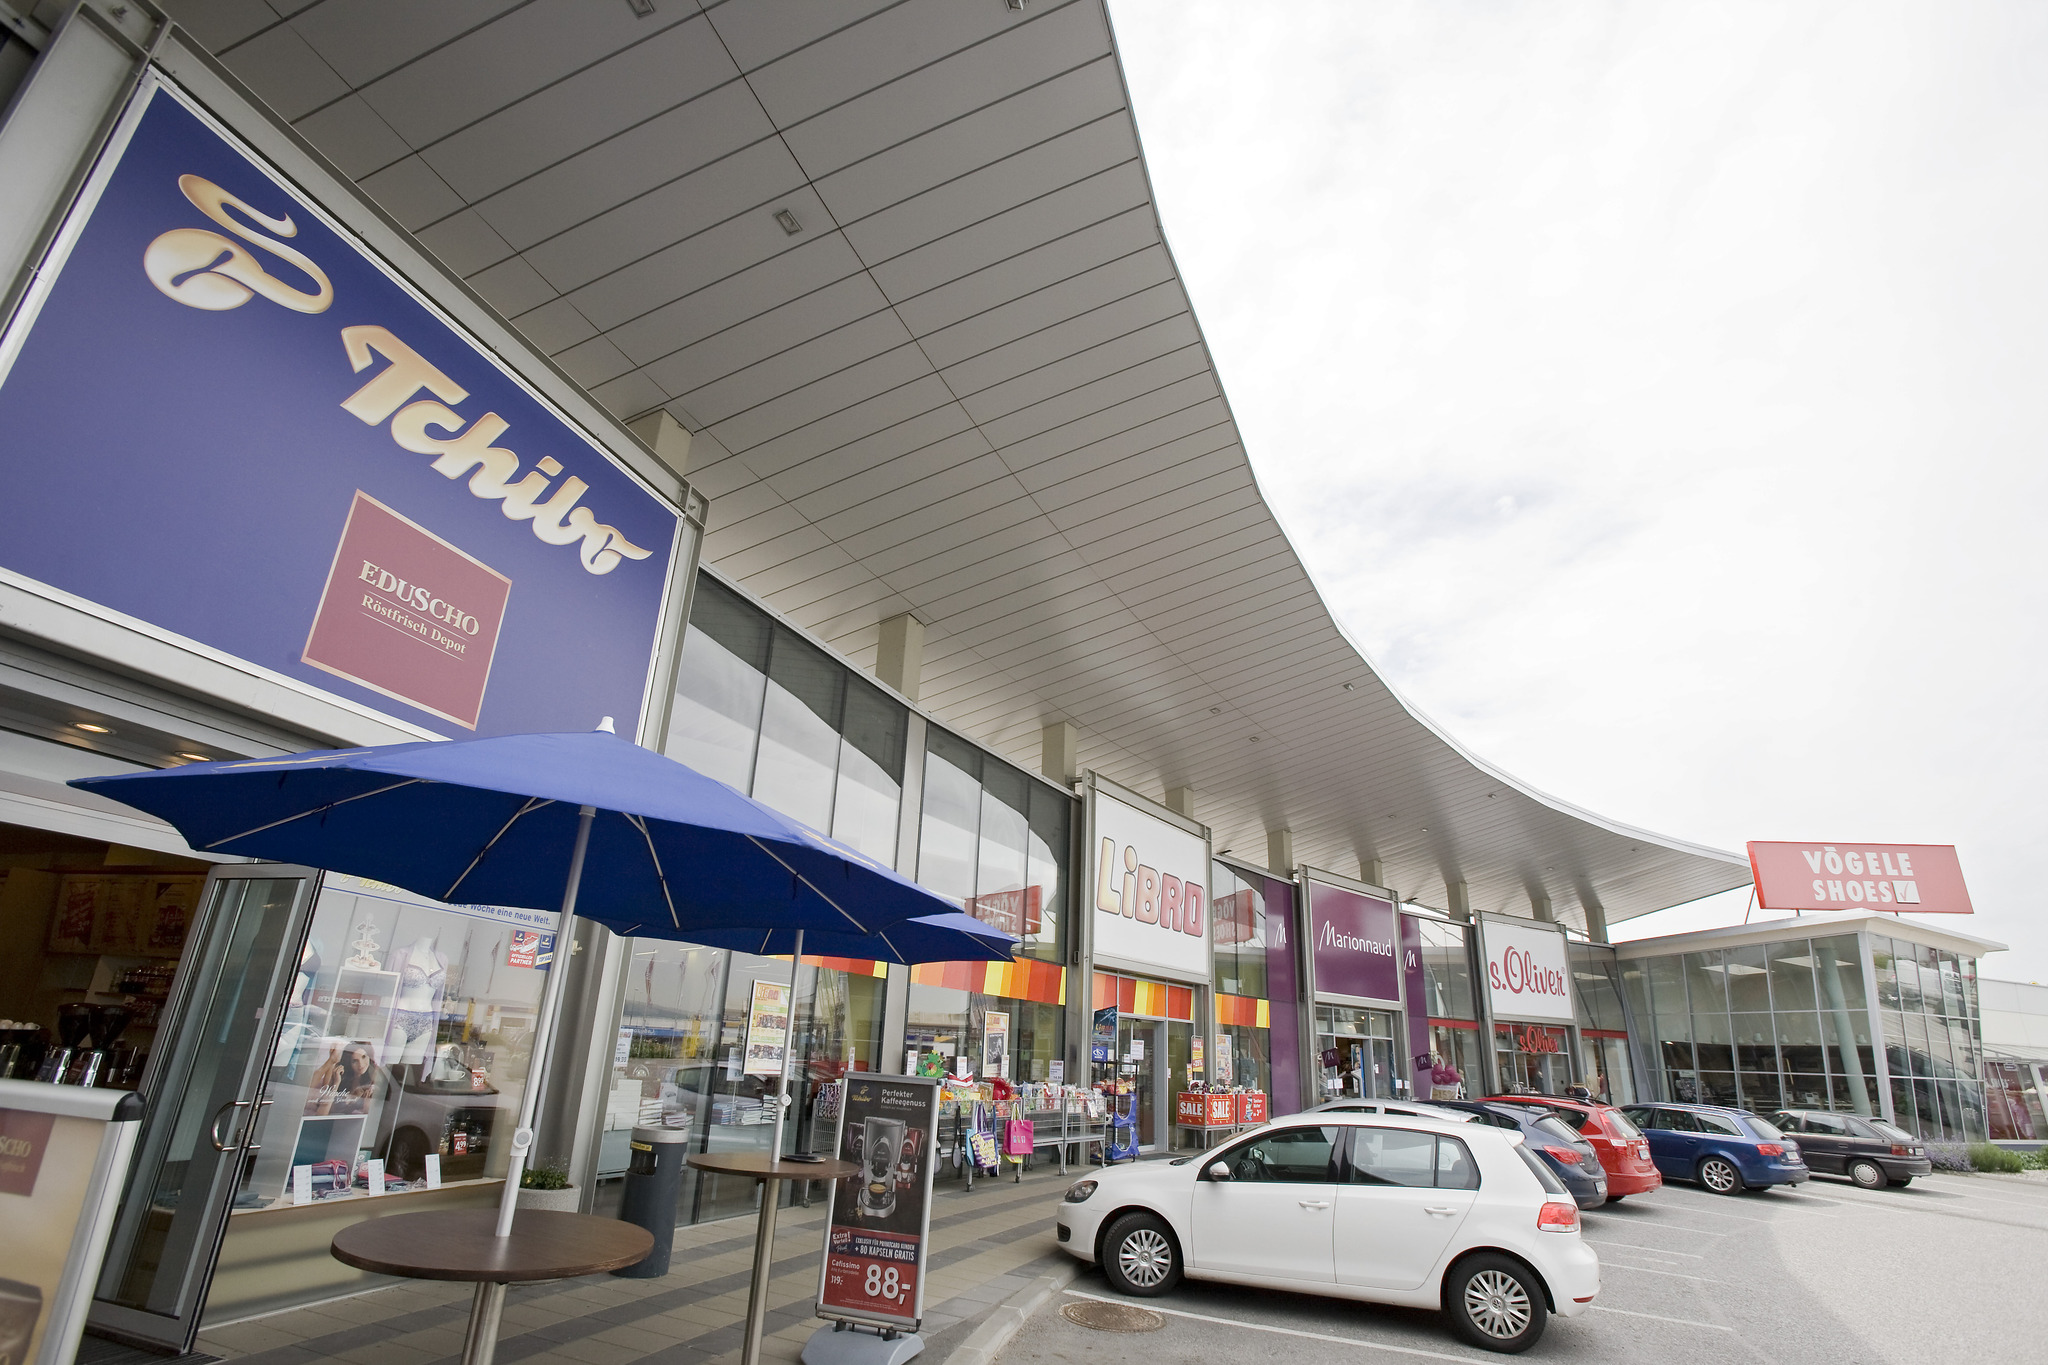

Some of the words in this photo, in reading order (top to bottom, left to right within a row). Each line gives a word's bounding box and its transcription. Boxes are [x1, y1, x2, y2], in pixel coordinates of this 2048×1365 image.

[339, 325, 654, 575] Tchibo
[358, 559, 480, 636] EDUSCHO
[361, 594, 428, 636] Röstfrisch
[430, 628, 467, 654] Depot
[1812, 879, 1892, 903] SHOES
[497, 908, 512, 918] eine
[514, 912, 532, 922] neue
[534, 914, 551, 925] Welt.
[1318, 920, 1392, 957] Marionnaud
[1489, 945, 1566, 997] s.Oliver
[1519, 1025, 1558, 1054] s.Oliver
[880, 1097, 926, 1108] Kaffeegenuss
[881, 1088, 914, 1098] Perfekter
[1180, 1102, 1203, 1116] SALE
[1212, 1100, 1229, 1118] SALE
[868, 1246, 893, 1258] KAPSELN
[894, 1250, 915, 1261] GRATIS
[831, 1259, 861, 1270] Cafissimo
